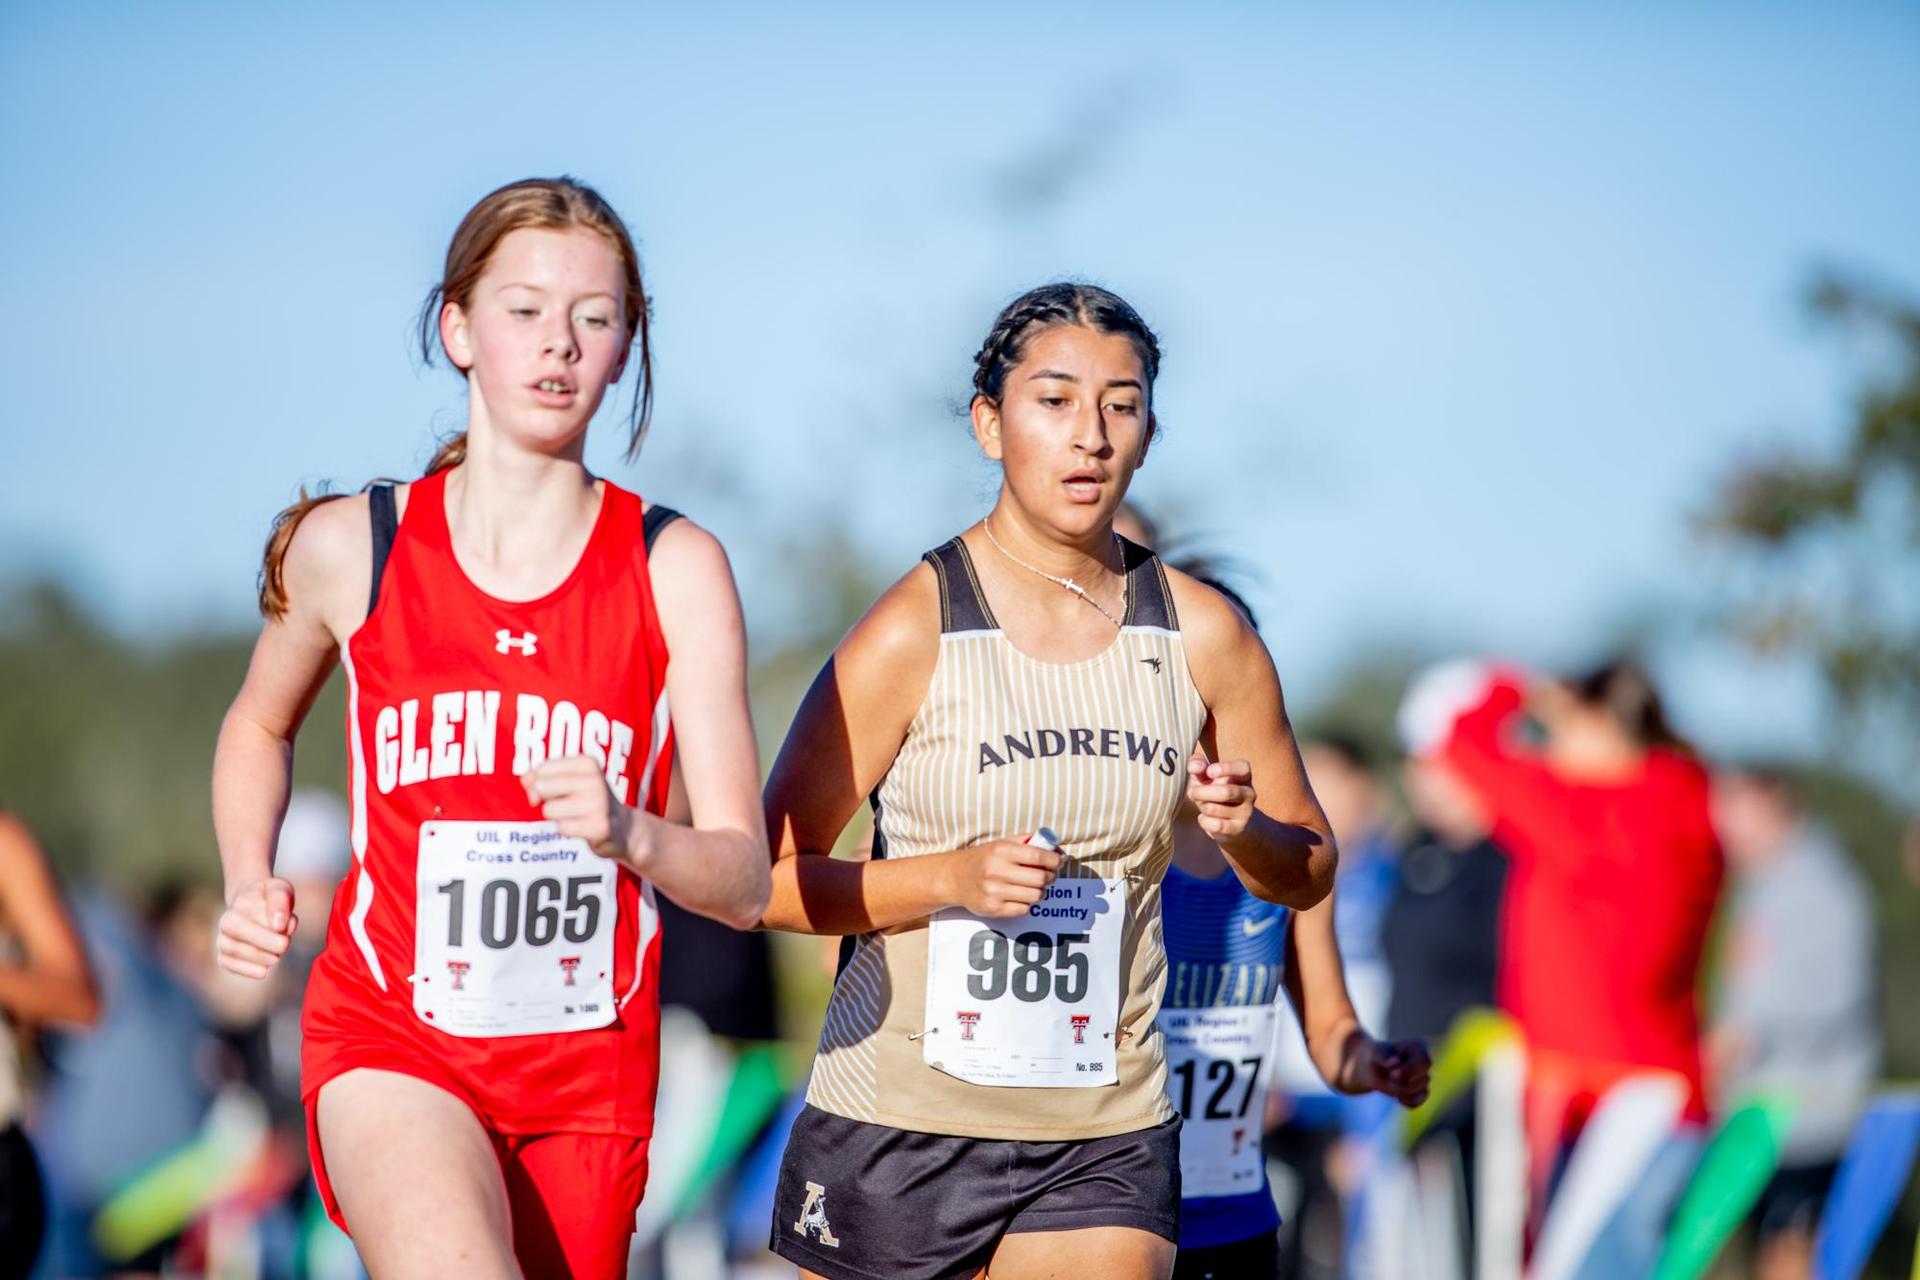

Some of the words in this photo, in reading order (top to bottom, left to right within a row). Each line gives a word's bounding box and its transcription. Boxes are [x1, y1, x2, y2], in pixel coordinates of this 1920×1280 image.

[375, 690, 501, 795] GLEN
[512, 693, 634, 805] ROSE
[979, 728, 1178, 776] ANDREWS
[476, 831, 501, 843] UIL
[466, 850, 513, 862] Cross
[520, 849, 578, 862] Country
[438, 875, 602, 949] 1065
[1029, 904, 1088, 920] Country
[967, 930, 1090, 1003] 985
[1075, 1062, 1088, 1072] No.
[1089, 1062, 1104, 1072] 985
